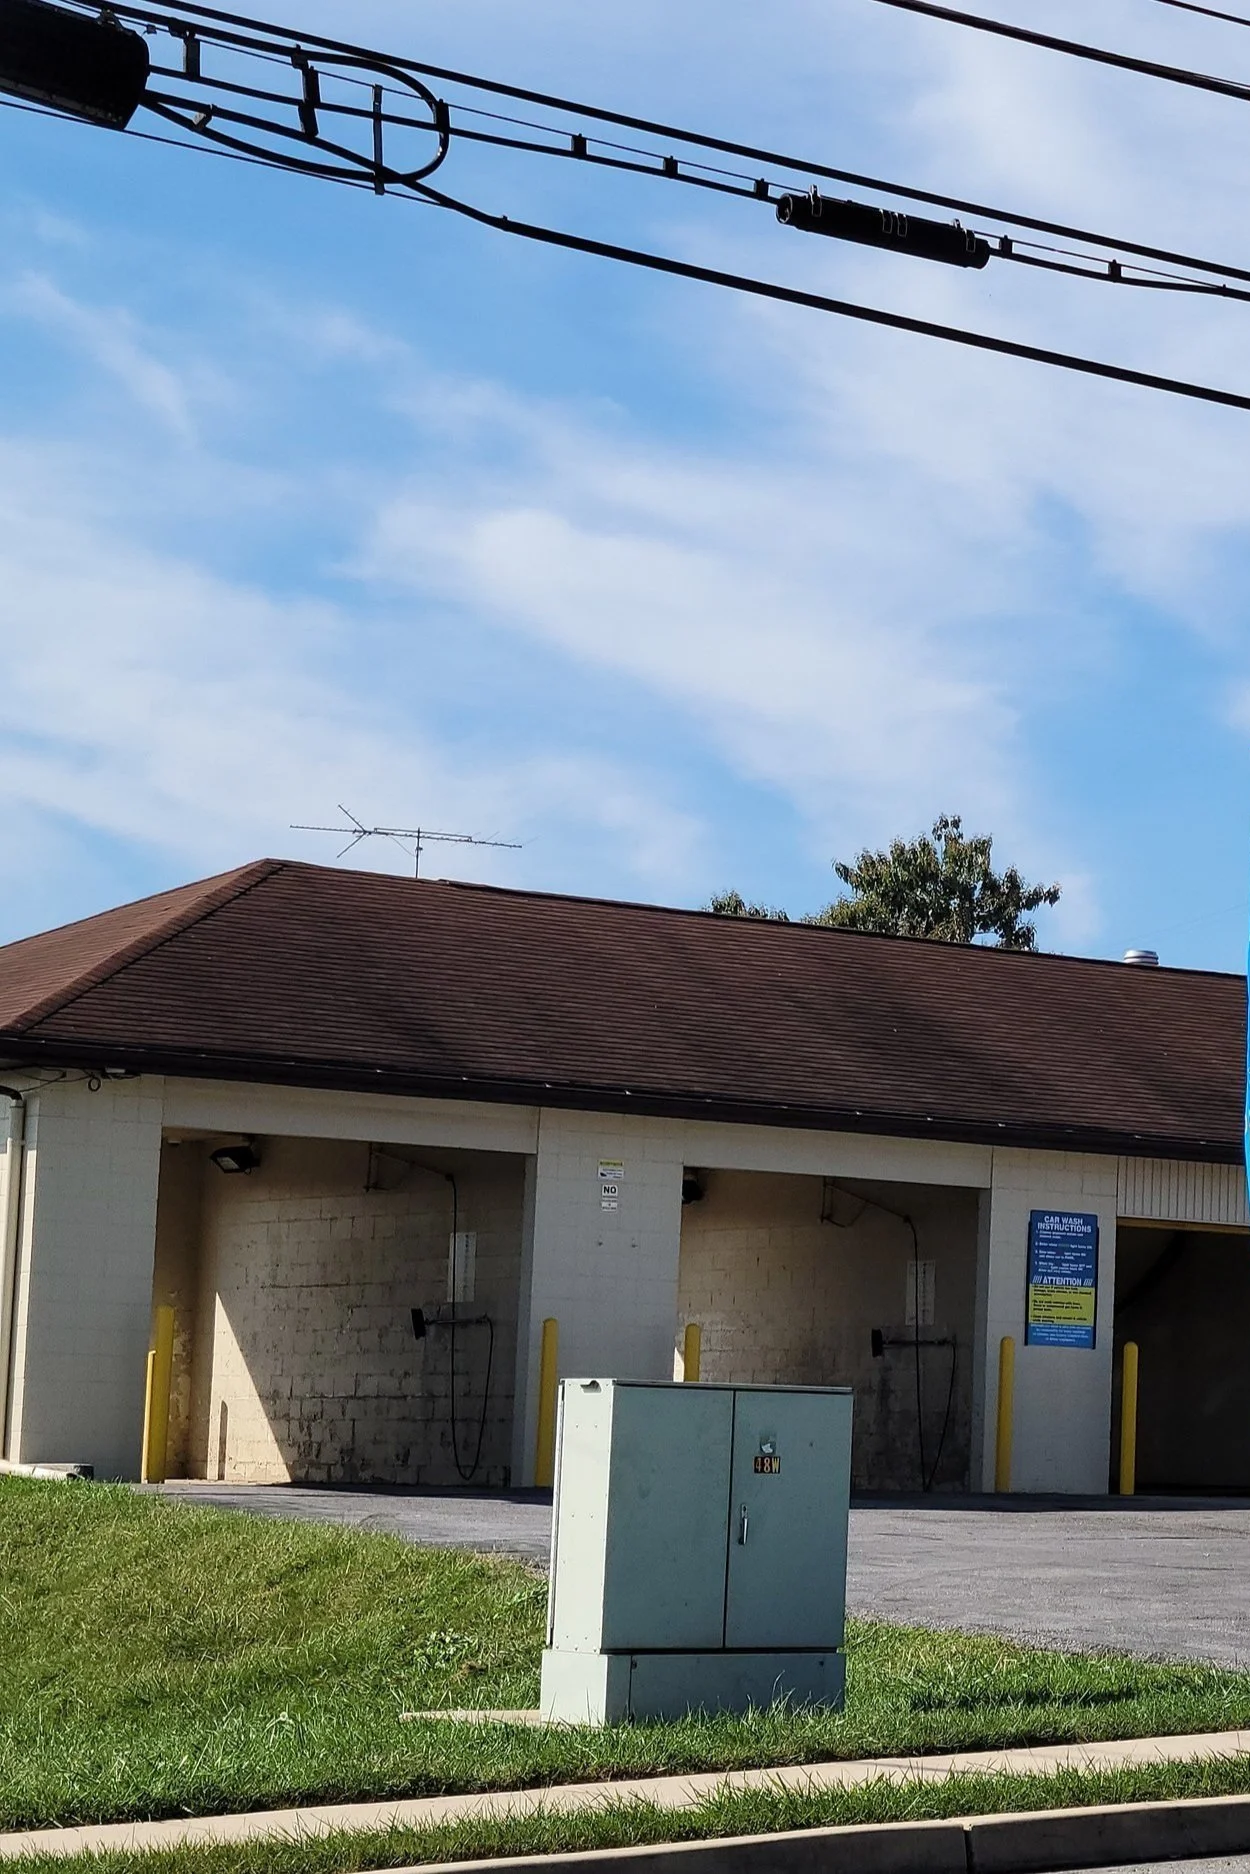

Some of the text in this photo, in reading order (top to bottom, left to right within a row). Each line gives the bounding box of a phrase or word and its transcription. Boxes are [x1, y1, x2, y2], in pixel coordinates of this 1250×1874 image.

[603, 1186, 617, 1194] NO
[1044, 1215, 1084, 1225] CAR WASH
[1038, 1222, 1092, 1233] INSTRUCTIONS
[1043, 1276, 1082, 1286] ATTENTION
[755, 1457, 780, 1474] 48W
